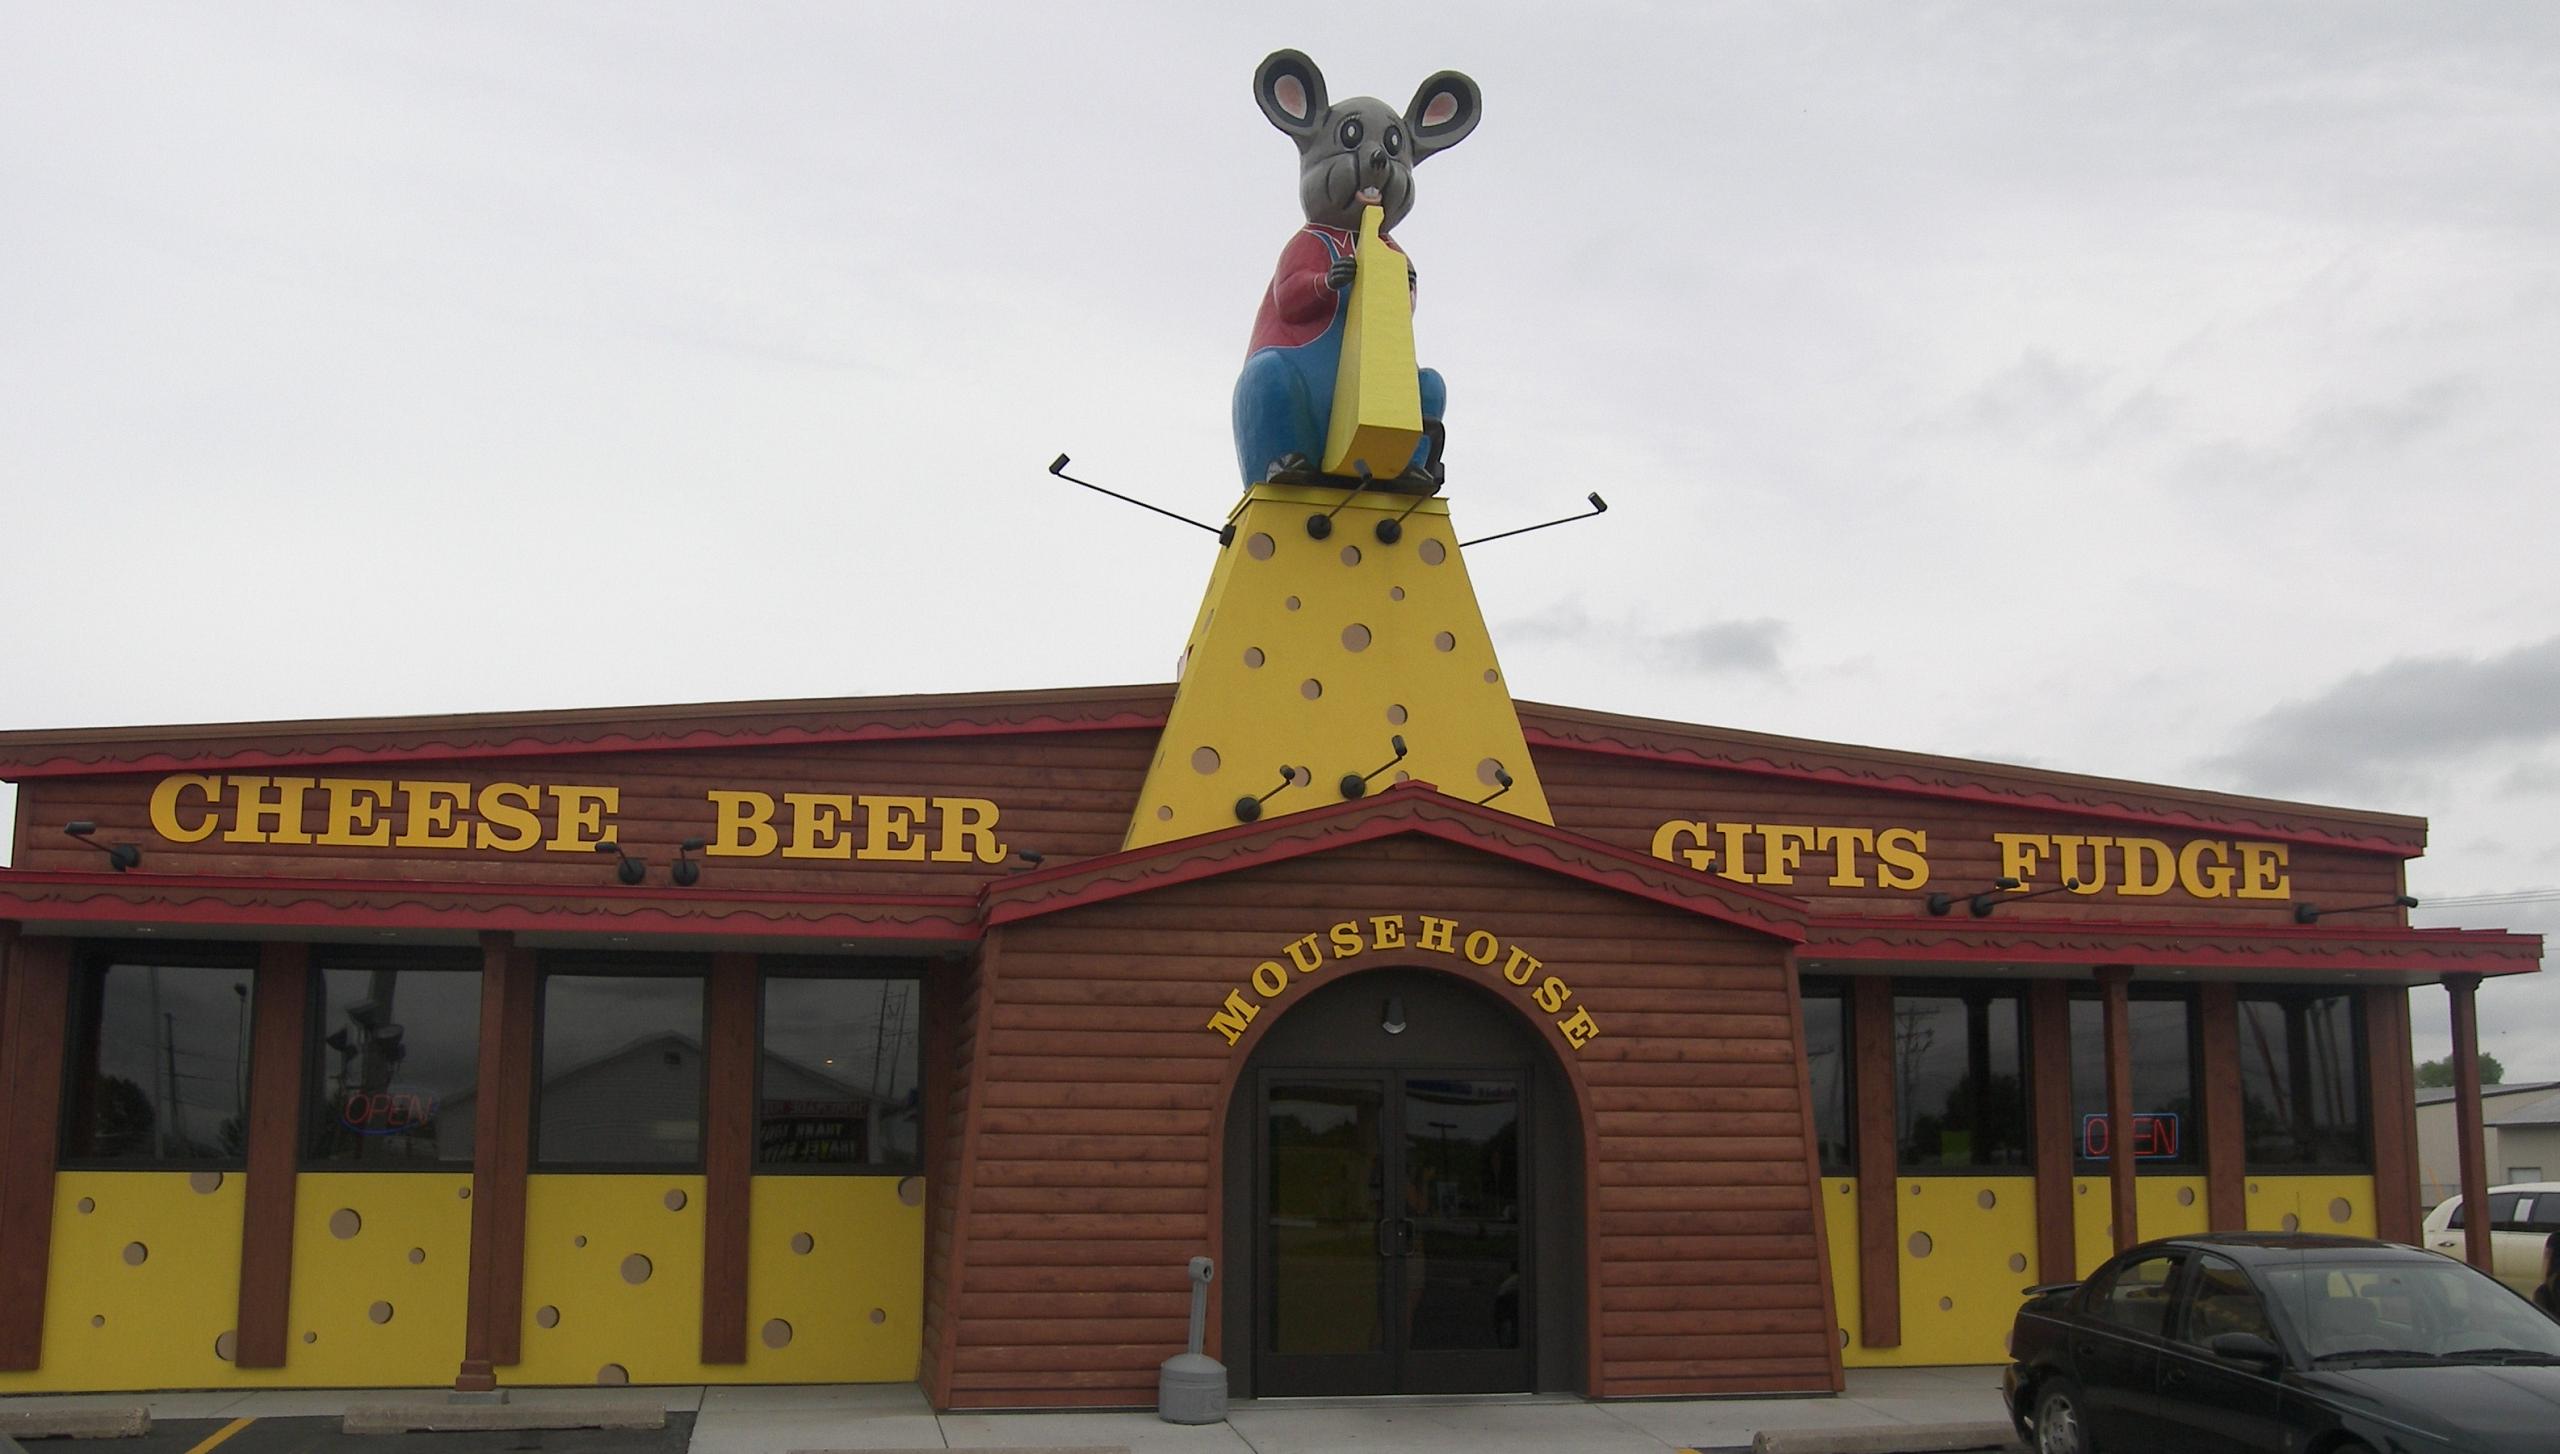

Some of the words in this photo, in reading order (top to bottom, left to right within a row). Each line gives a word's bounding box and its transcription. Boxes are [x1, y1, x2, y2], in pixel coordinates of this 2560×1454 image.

[150, 775, 620, 853] CHEESE
[705, 790, 1008, 864] BEER
[1651, 819, 1930, 890] GIFTS
[1993, 832, 2291, 901] FUDGE
[346, 1092, 433, 1125] OPEN
[2086, 1116, 2176, 1155] OEN
